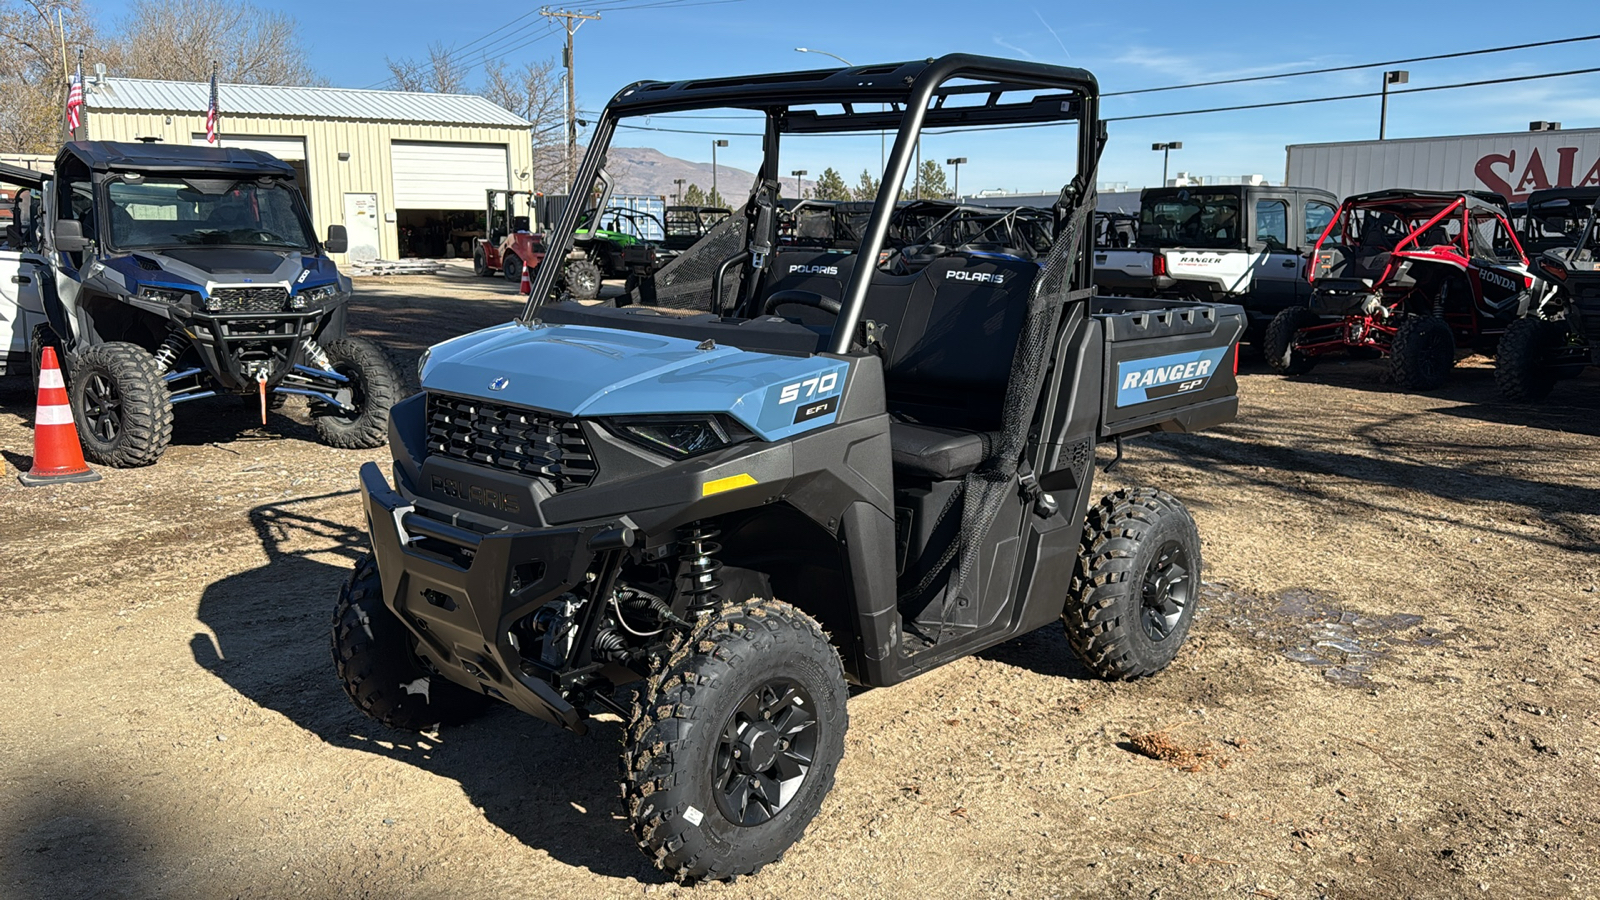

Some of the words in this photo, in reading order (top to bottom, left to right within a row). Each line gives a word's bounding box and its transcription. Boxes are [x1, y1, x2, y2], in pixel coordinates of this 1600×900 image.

[788, 264, 838, 275] POLARIS
[945, 270, 1004, 284] POLARIS
[1479, 268, 1517, 291] HONDA
[1121, 359, 1212, 390] RANGER
[778, 372, 838, 405] 570
[1177, 379, 1203, 392] SP
[805, 403, 828, 416] EFI
[430, 474, 521, 514] POLARIS
